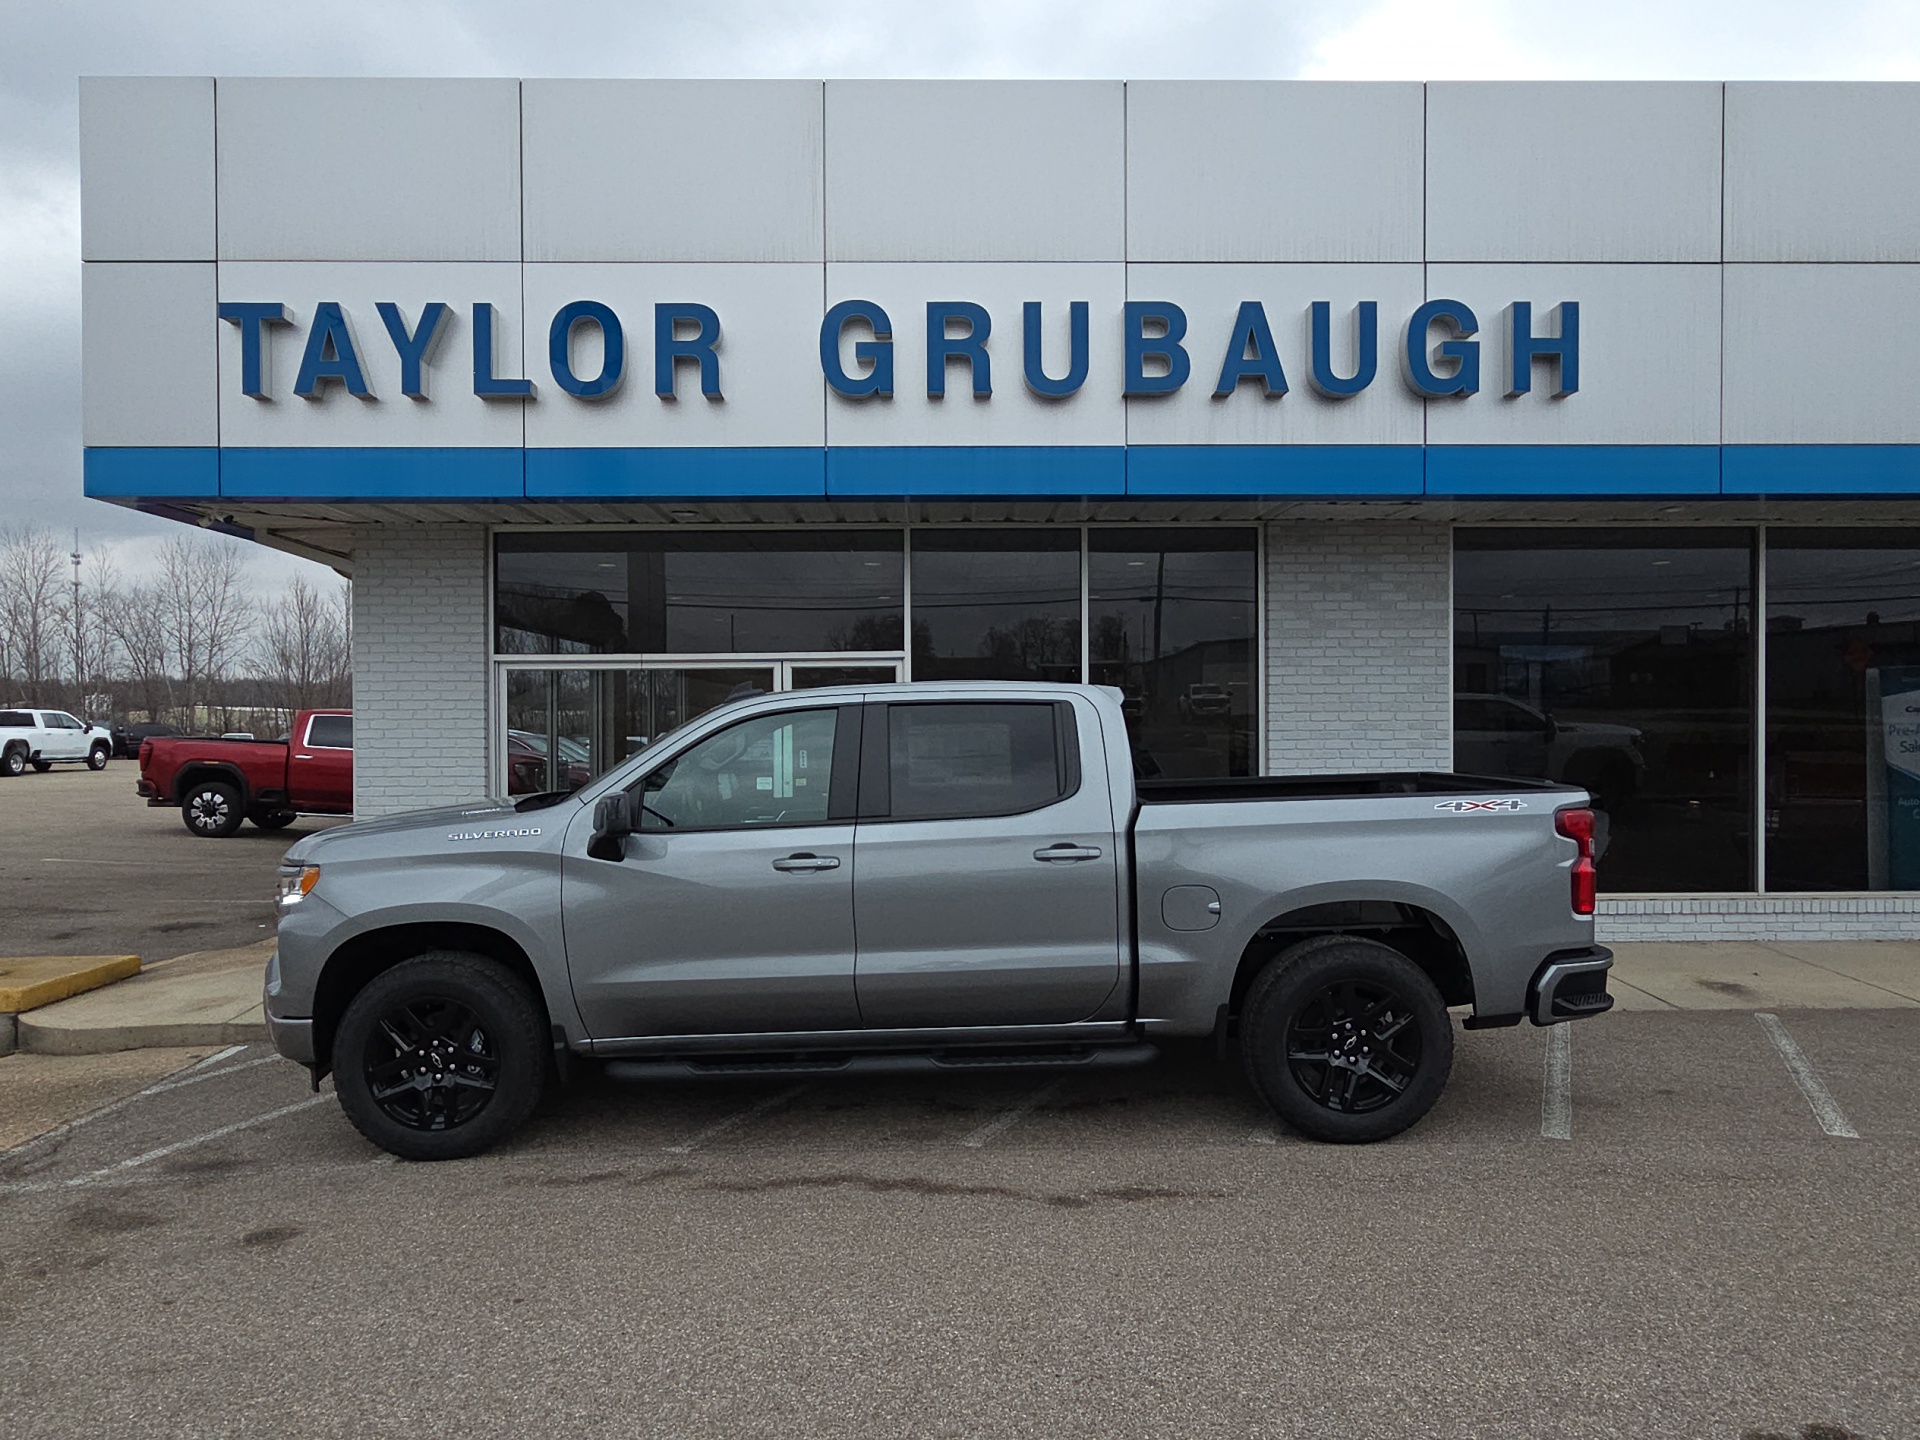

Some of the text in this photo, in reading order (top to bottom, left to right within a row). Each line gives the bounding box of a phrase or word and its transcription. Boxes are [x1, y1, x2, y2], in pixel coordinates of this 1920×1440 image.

[218, 299, 1580, 401] TAYLOR GRUBAUGH
[447, 828, 542, 842] SILVERADO
